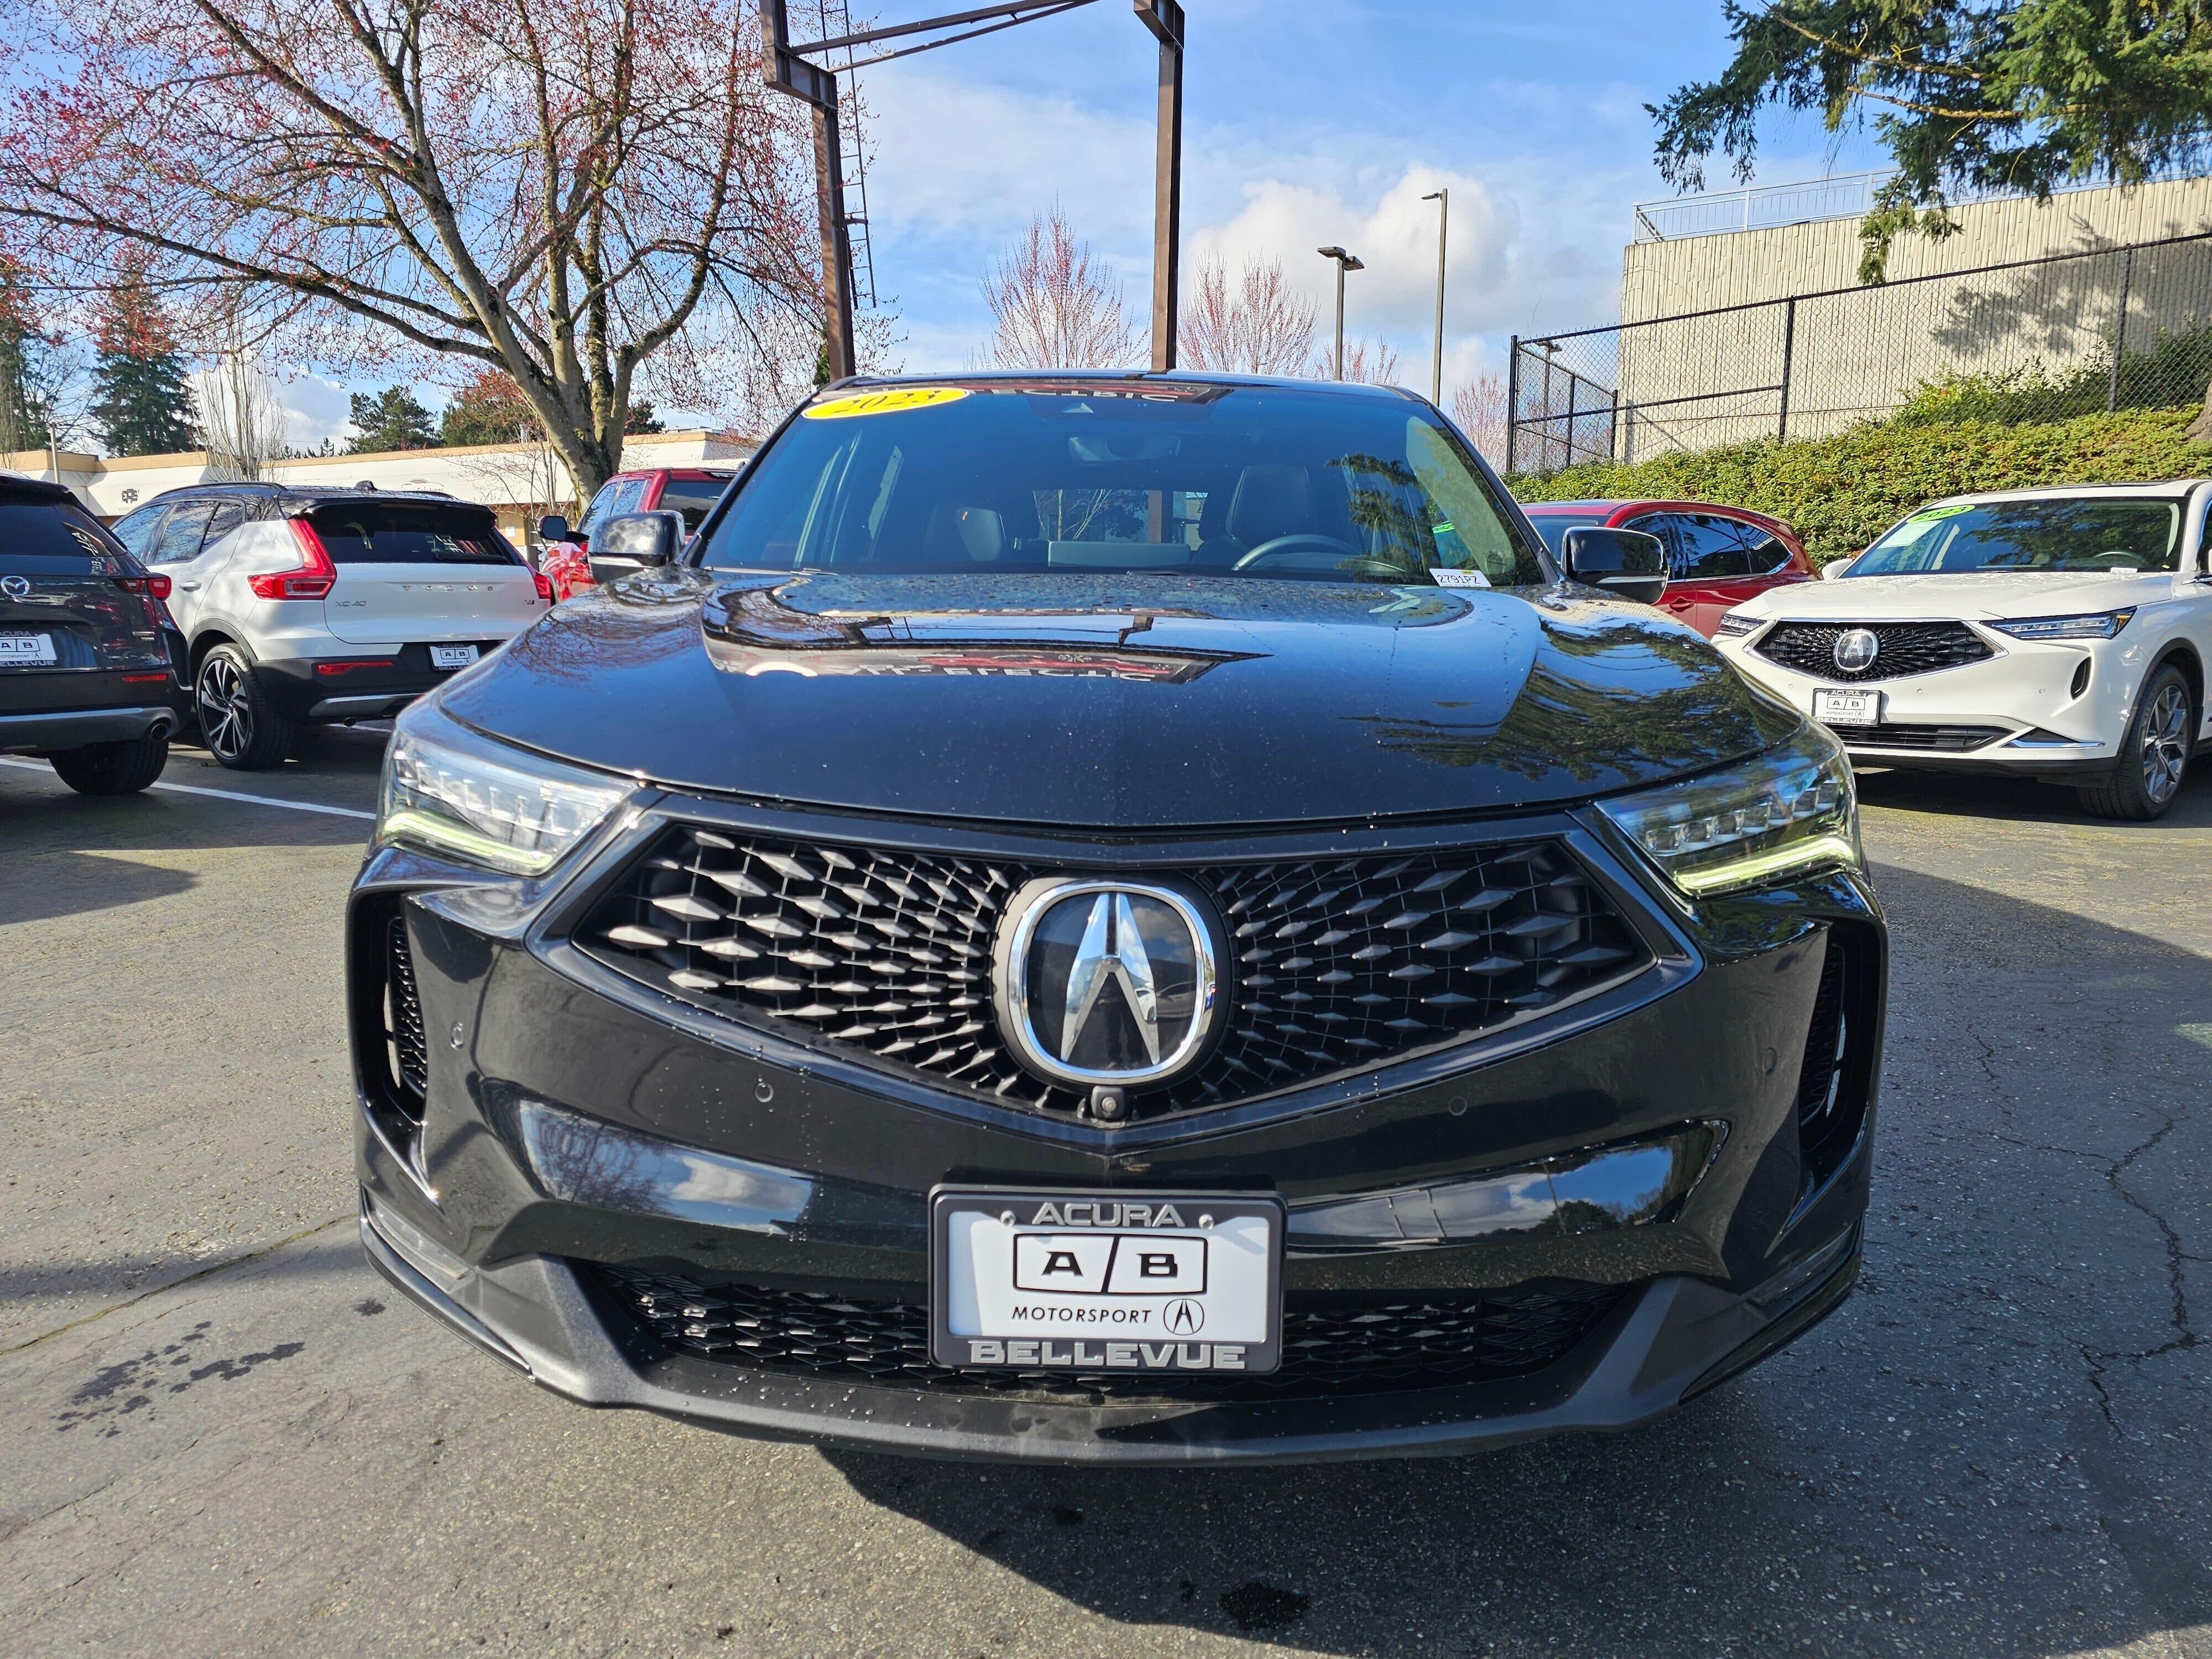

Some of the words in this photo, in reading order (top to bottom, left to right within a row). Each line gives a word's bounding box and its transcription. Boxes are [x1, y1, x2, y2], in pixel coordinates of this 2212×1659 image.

[831, 390, 942, 414] 2023
[1913, 507, 1968, 521] 2023
[1031, 1201, 1185, 1228] ACURA
[1041, 1251, 1084, 1277] A
[1136, 1253, 1178, 1278] B
[1011, 1306, 1152, 1324] MOTORSPORT
[967, 1340, 1246, 1370] BELLEVUE
